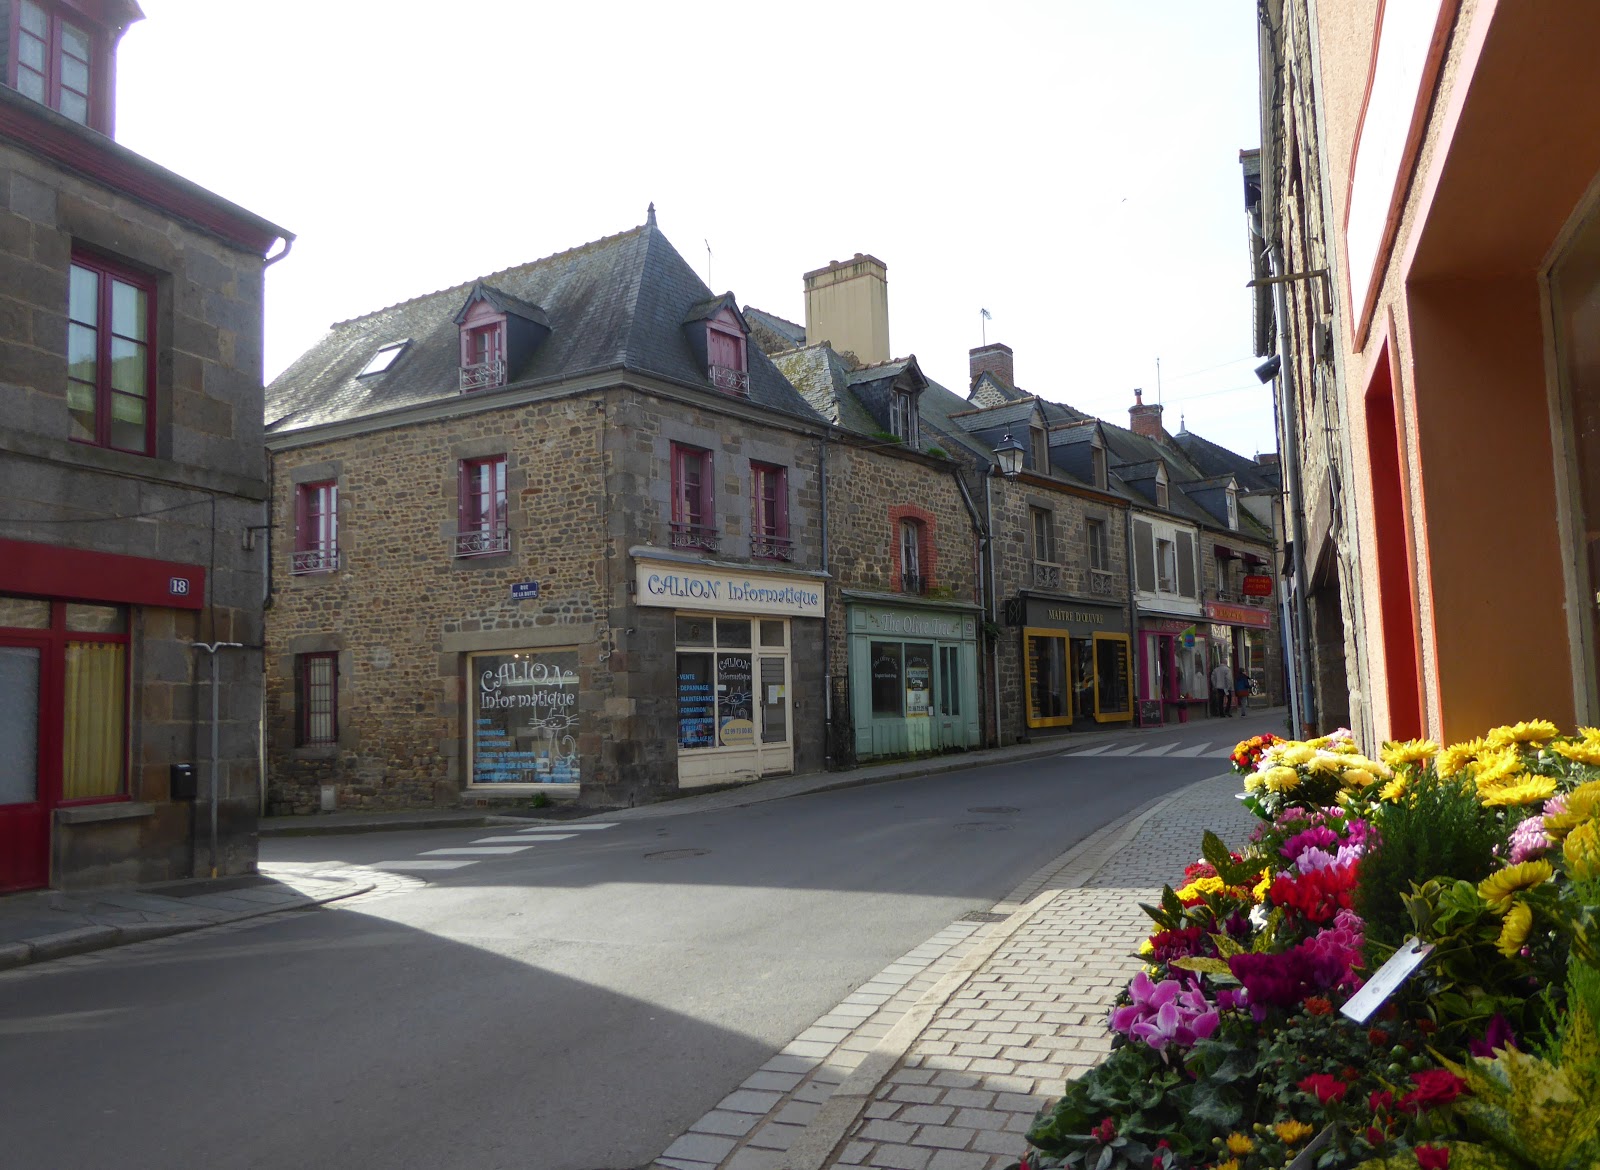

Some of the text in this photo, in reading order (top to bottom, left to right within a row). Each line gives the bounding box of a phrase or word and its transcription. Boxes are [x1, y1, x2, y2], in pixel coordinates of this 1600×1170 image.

[171, 580, 187, 594] 18
[647, 573, 818, 609] CALION Informatique
[880, 612, 951, 636] The Olive Tree
[719, 657, 751, 670] CALION
[480, 661, 573, 692] CALION
[481, 690, 575, 710] Informatique
